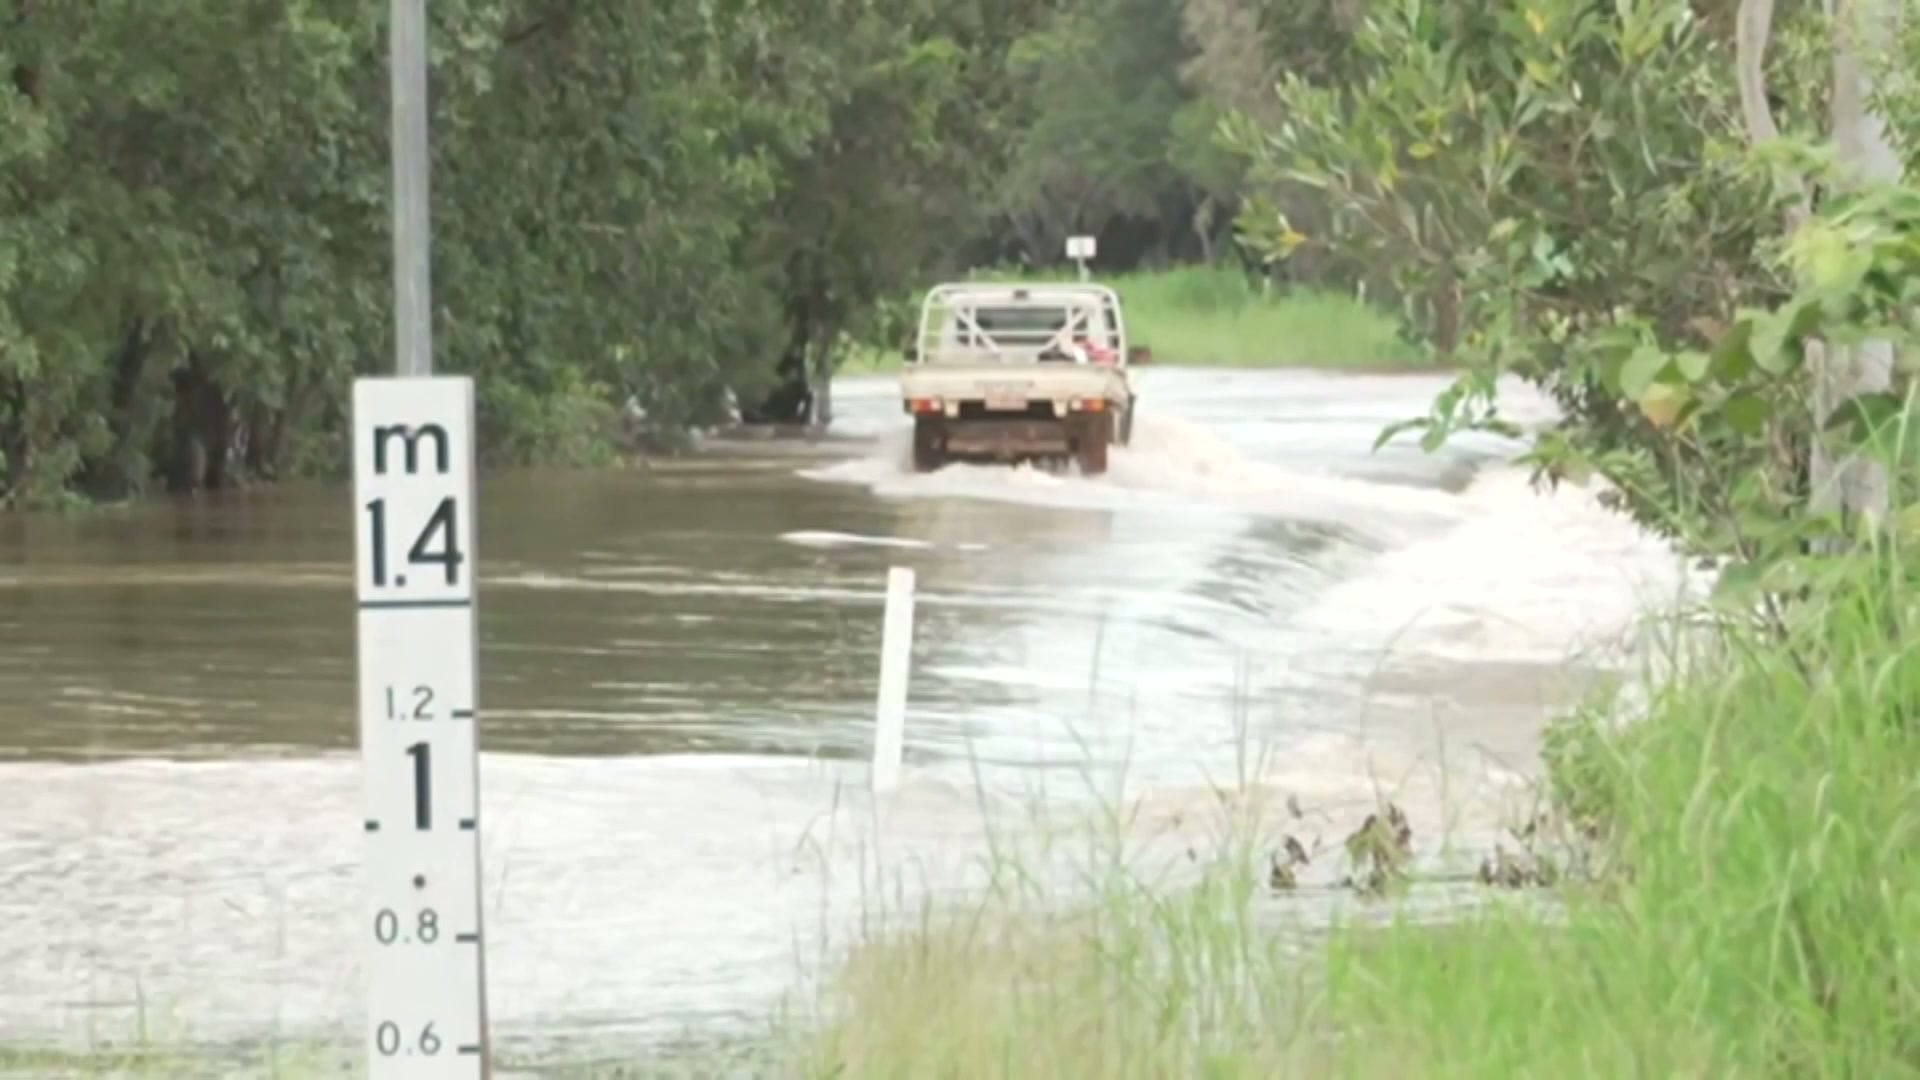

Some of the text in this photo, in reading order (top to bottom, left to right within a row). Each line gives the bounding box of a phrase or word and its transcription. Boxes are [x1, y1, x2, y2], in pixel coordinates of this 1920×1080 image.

[373, 422, 449, 475] m
[366, 496, 464, 587] 1.4
[386, 685, 435, 720] 1.2
[406, 741, 431, 831] 1
[374, 908, 439, 945] 0.8
[376, 1021, 442, 1056] 0.6
